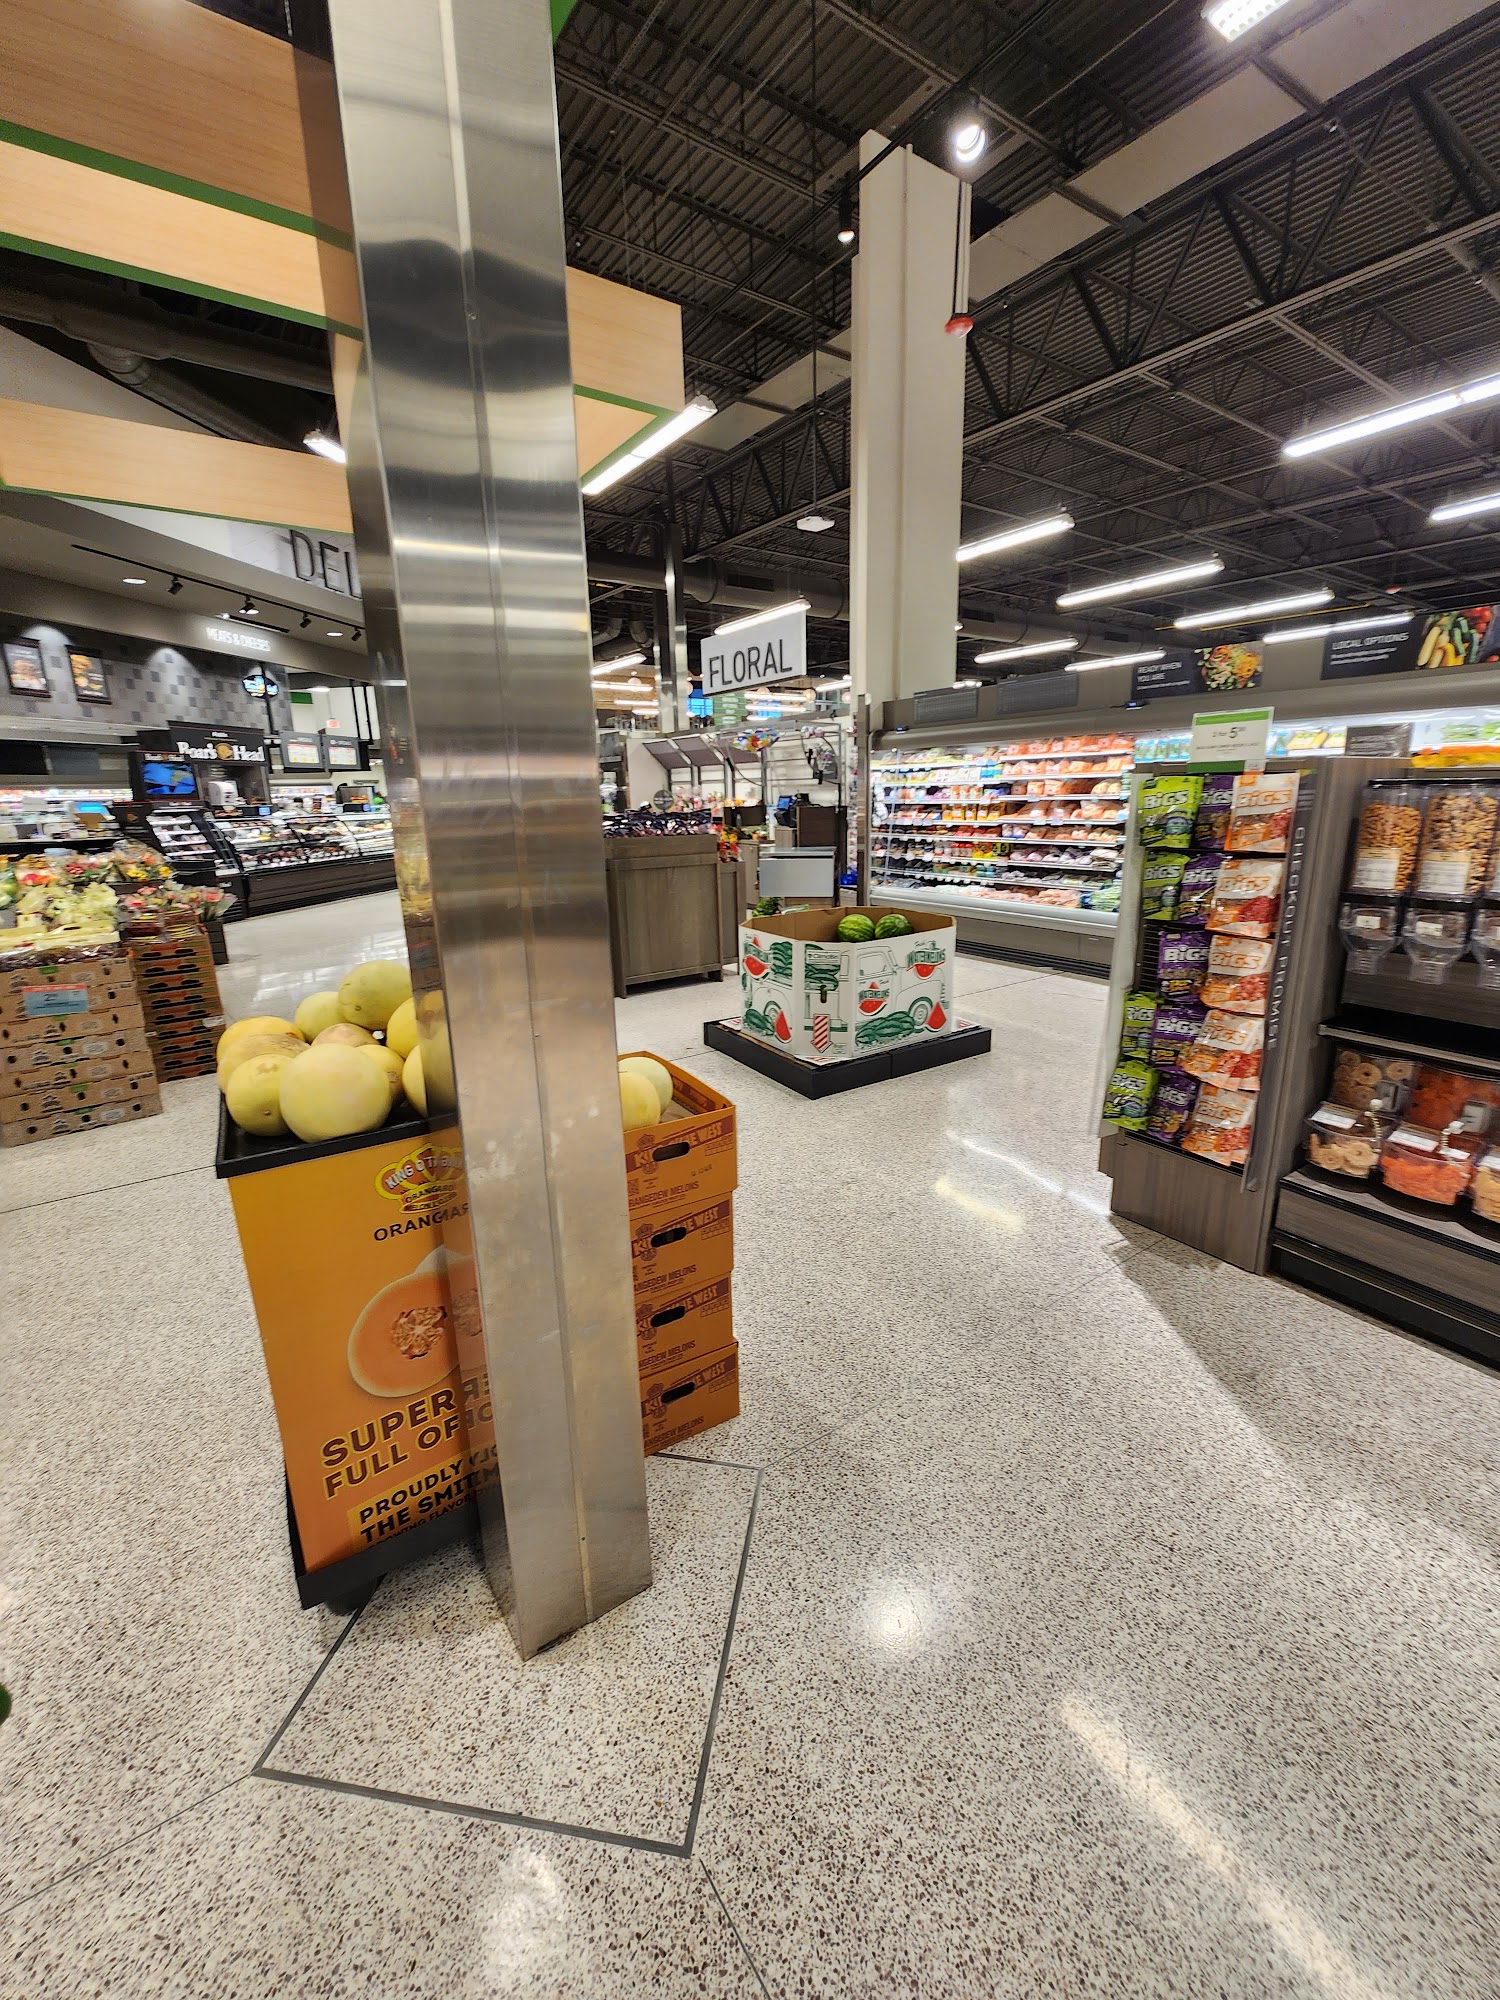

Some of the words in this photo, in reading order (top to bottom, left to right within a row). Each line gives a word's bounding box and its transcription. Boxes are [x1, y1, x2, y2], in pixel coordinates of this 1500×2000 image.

[1332, 639, 1363, 651] LOCAL
[1364, 632, 1410, 648] OPTIONS
[709, 639, 793, 687] FLORAL
[232, 745, 266, 762] Head
[385, 1165, 414, 1190] KING
[670, 1180, 699, 1196] MELONS
[668, 1264, 697, 1279] MELONS
[668, 1340, 697, 1357] MELONS
[322, 1389, 458, 1467] SUPER
[677, 1416, 704, 1434] MELONS
[324, 1443, 409, 1500] FULL
[417, 1415, 461, 1451] OF
[359, 1458, 464, 1524] PROUDLY
[361, 1509, 411, 1544] THE
